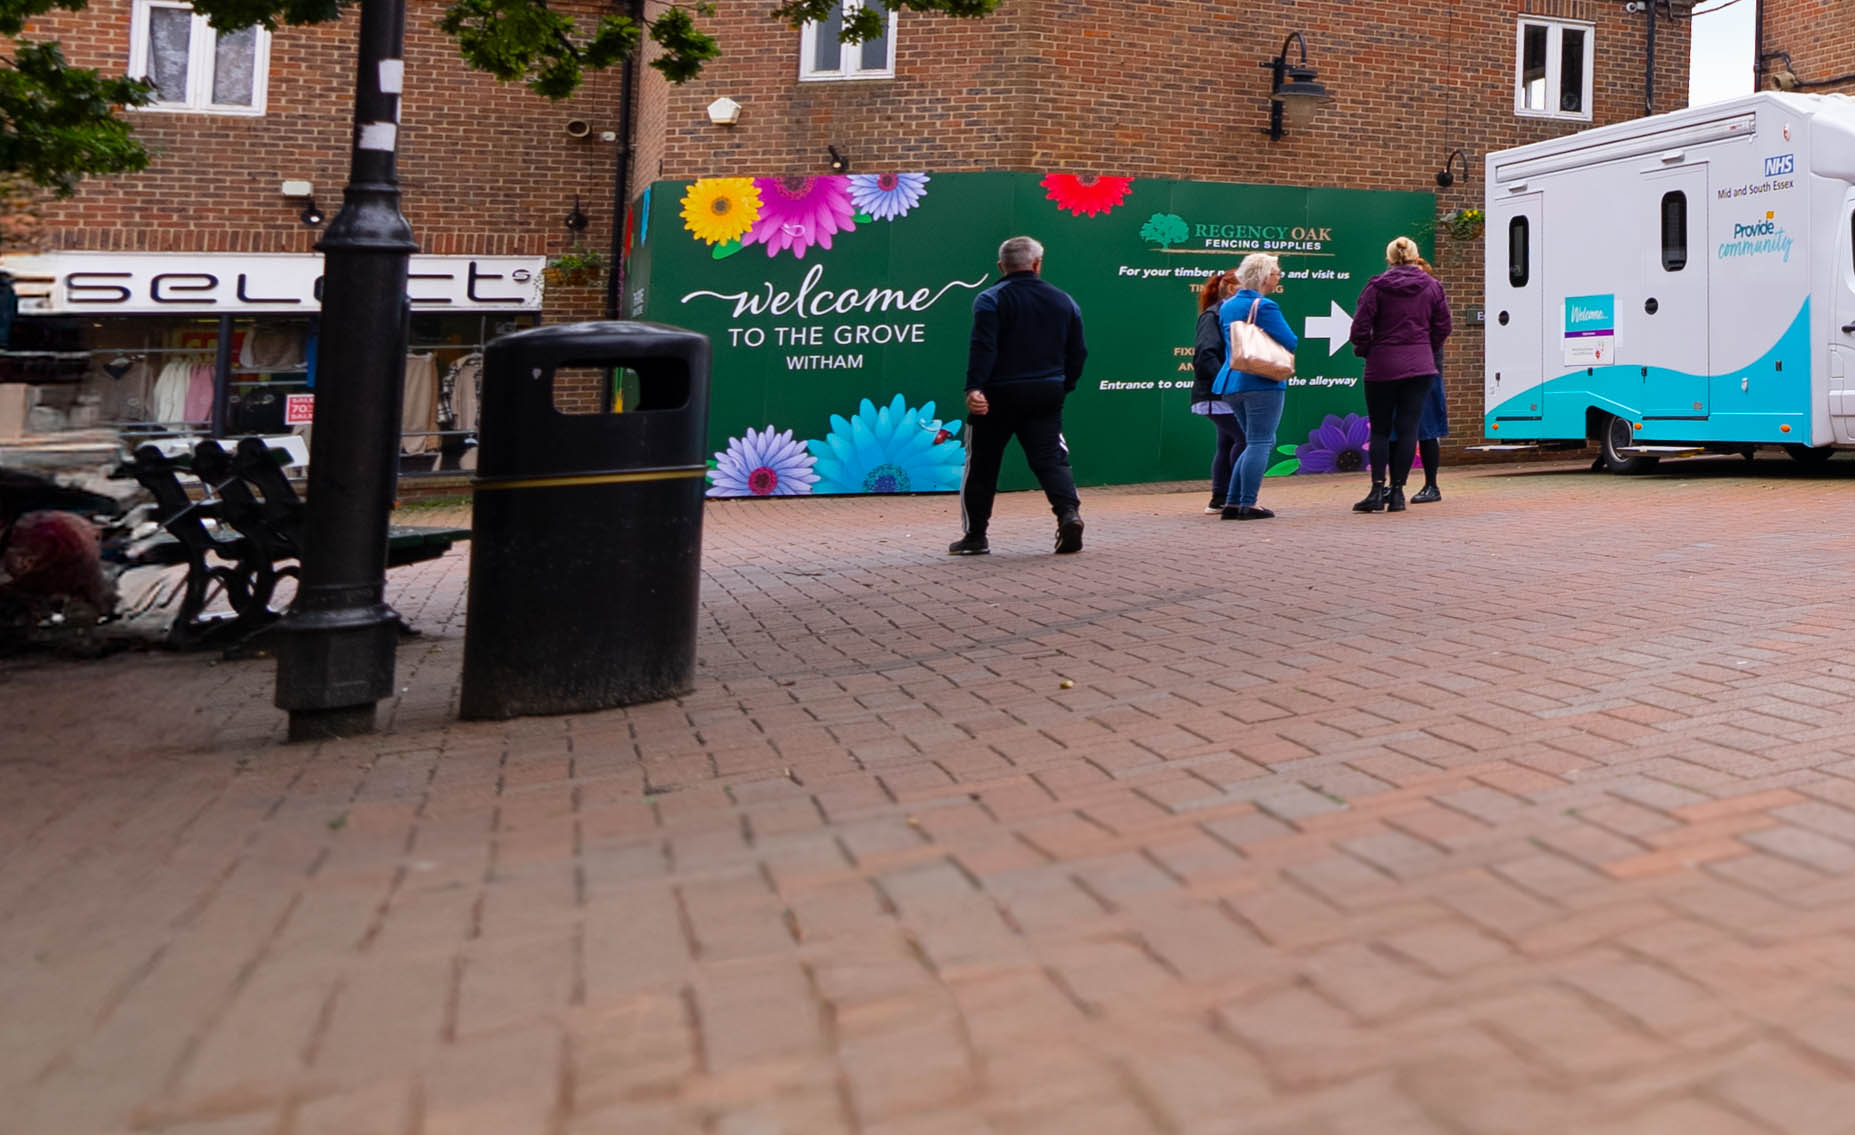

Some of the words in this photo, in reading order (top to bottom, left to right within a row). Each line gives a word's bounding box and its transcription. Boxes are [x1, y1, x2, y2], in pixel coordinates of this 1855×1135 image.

[1765, 155, 1793, 176] NHS
[1717, 189, 1732, 200] Mid
[1733, 185, 1747, 197] and
[1749, 182, 1771, 195] South
[1773, 179, 1794, 191] Essex
[1195, 223, 1290, 241] REGENCY
[1291, 226, 1333, 241] OAK
[1733, 219, 1775, 239] Provide
[1205, 238, 1260, 250] FENCING
[1263, 240, 1322, 251] SUPPLIES
[1718, 227, 1794, 263] community
[1118, 266, 1141, 277] For
[1141, 268, 1173, 279] your
[1174, 266, 1213, 278] timber
[1288, 269, 1309, 279] and
[1311, 269, 1335, 280] visit
[1336, 270, 1350, 280] us
[681, 263, 990, 319] welcome
[728, 327, 765, 348] TO
[774, 325, 824, 347] THE
[833, 323, 926, 345] GROVE
[786, 354, 864, 371] WITHAM
[1099, 379, 1155, 391] Entrance
[1158, 379, 1172, 389] to
[1175, 380, 1195, 389] our
[1288, 375, 1306, 386] the
[1309, 375, 1358, 388] alleyway
